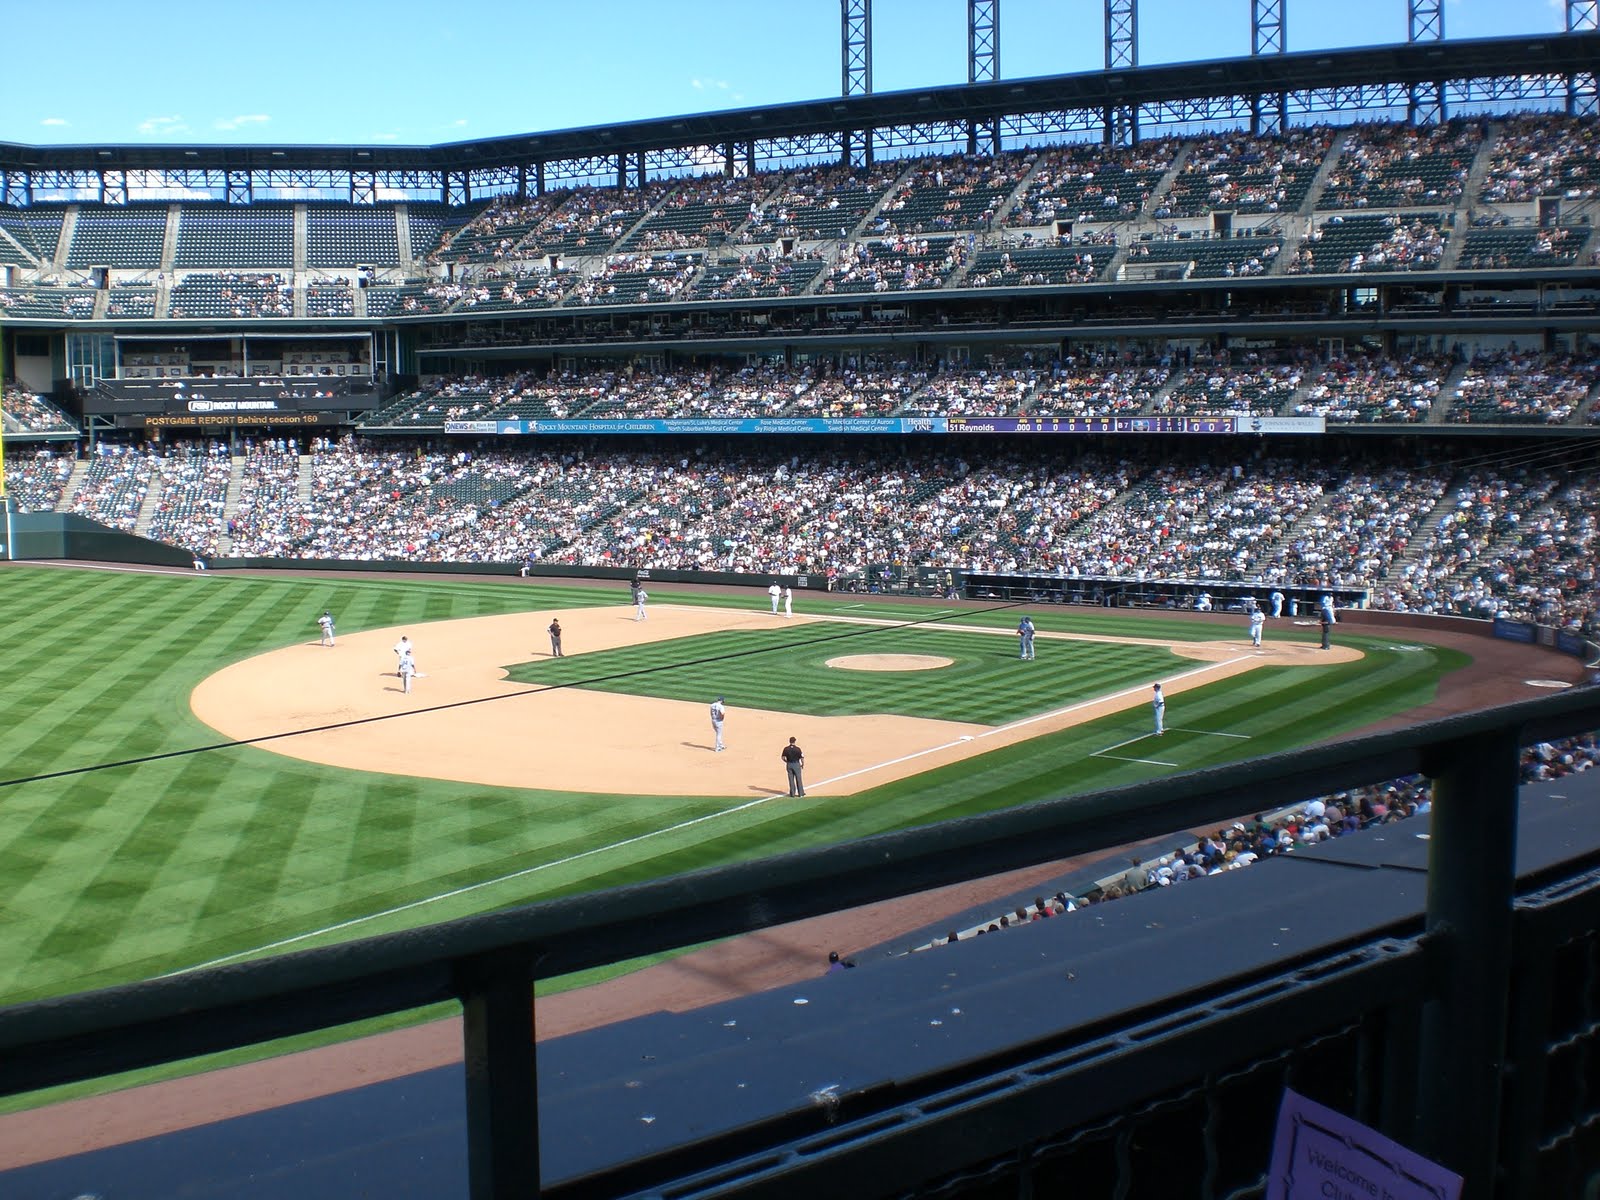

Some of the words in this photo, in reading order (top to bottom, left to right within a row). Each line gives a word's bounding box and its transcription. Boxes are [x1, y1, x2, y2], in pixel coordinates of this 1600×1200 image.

[213, 401, 236, 410] ROCKY
[237, 401, 274, 410] MOUNTAIN
[146, 417, 196, 425] POSTGAME
[198, 416, 235, 424] REPORT
[237, 416, 267, 424] Behind
[302, 415, 318, 423] 160
[557, 423, 588, 431] MOUNTAIN
[589, 423, 616, 431] HOSPITAL
[624, 422, 655, 431] CHILDREN
[959, 424, 995, 432] Reynolds
[1193, 423, 1199, 431] 0
[1208, 423, 1215, 431] 0
[1224, 423, 1231, 431] 2
[1306, 1143, 1377, 1197] Welcome
